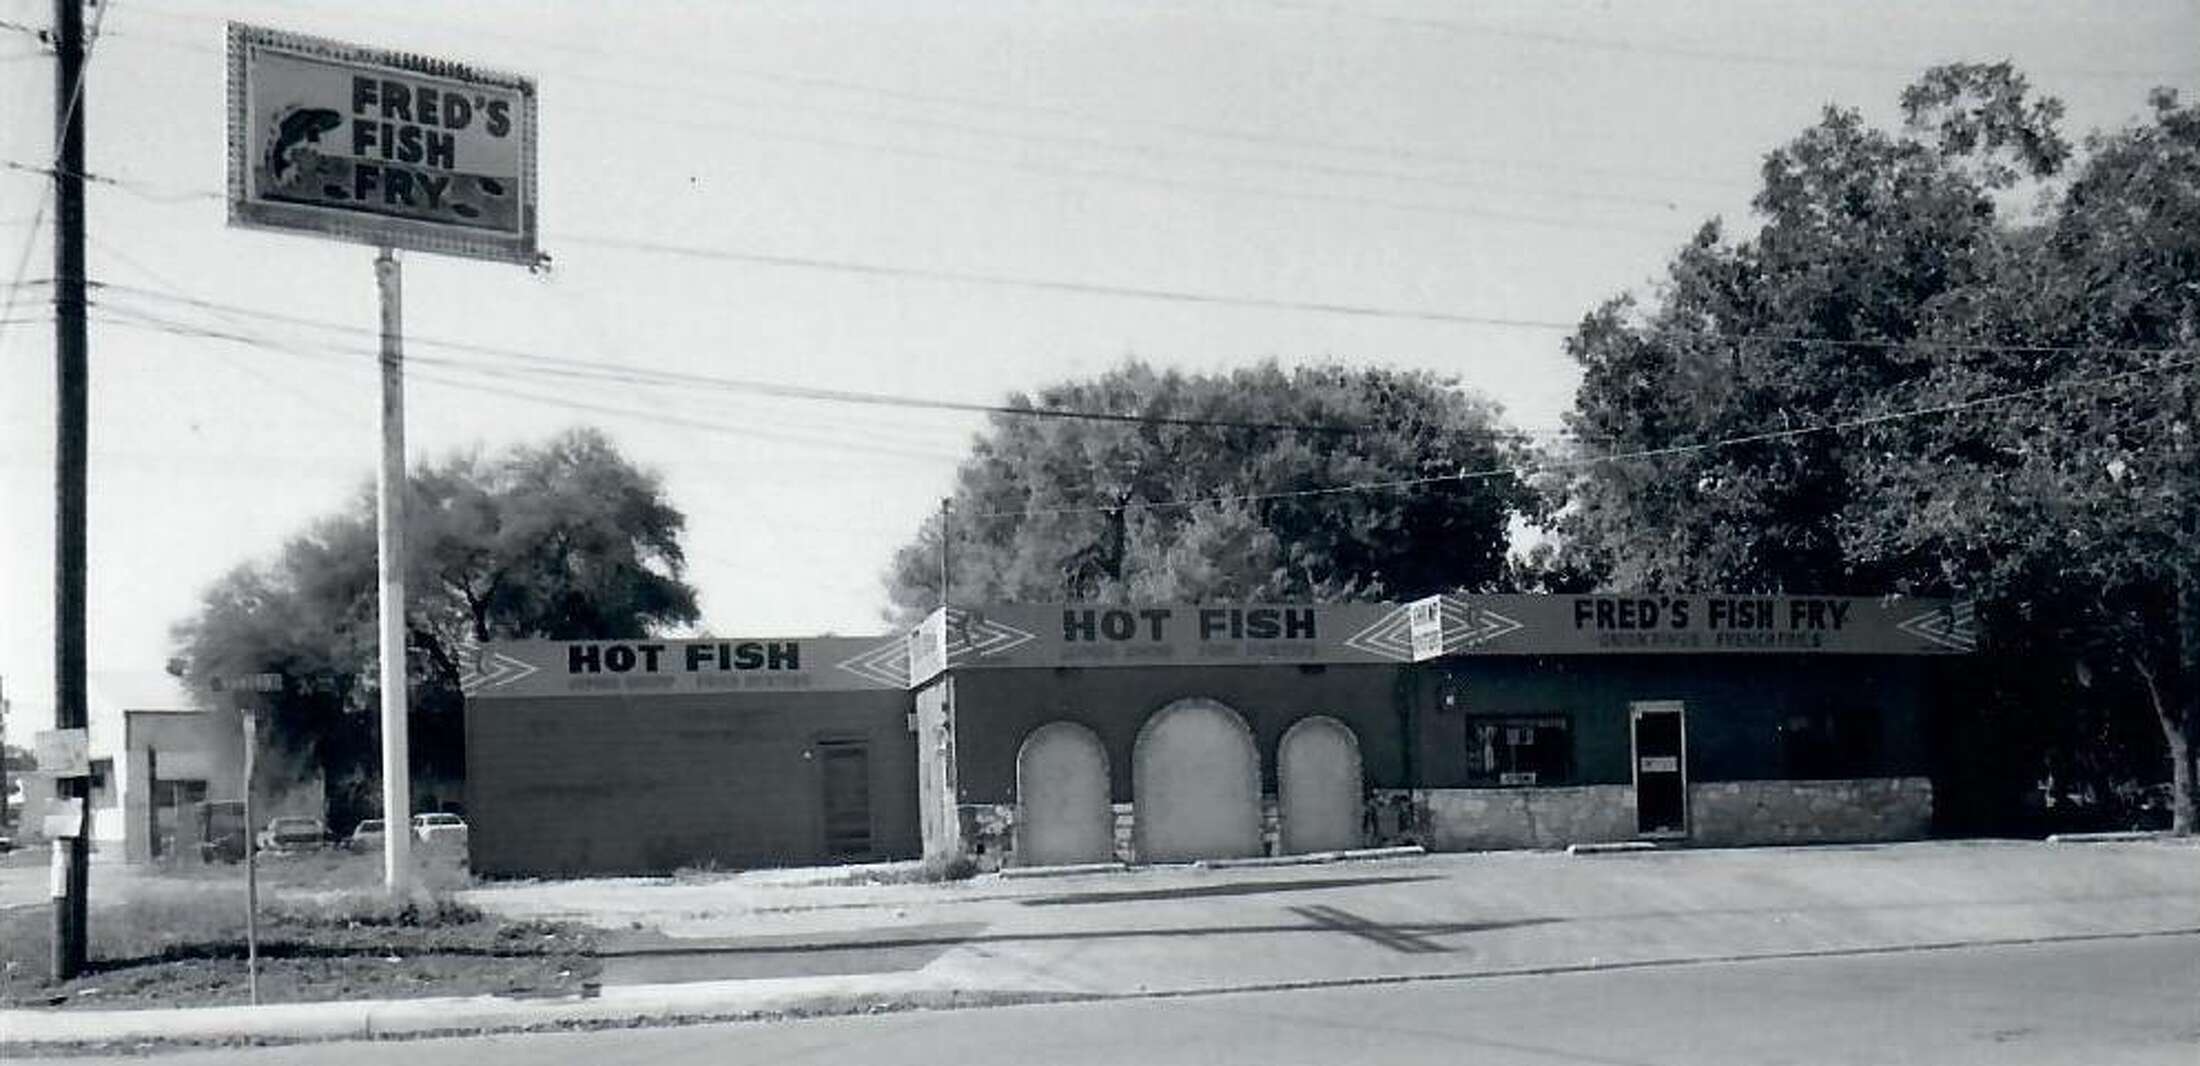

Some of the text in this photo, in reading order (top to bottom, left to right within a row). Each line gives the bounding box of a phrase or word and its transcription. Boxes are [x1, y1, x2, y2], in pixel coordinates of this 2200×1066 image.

[353, 75, 512, 138] FRED'S
[353, 119, 455, 169] FISH
[355, 164, 450, 210] FRY
[1063, 608, 1316, 641] HOT FISH
[1574, 597, 1850, 630] FRED'S FISH FRY
[568, 642, 799, 674] HOT FISH
